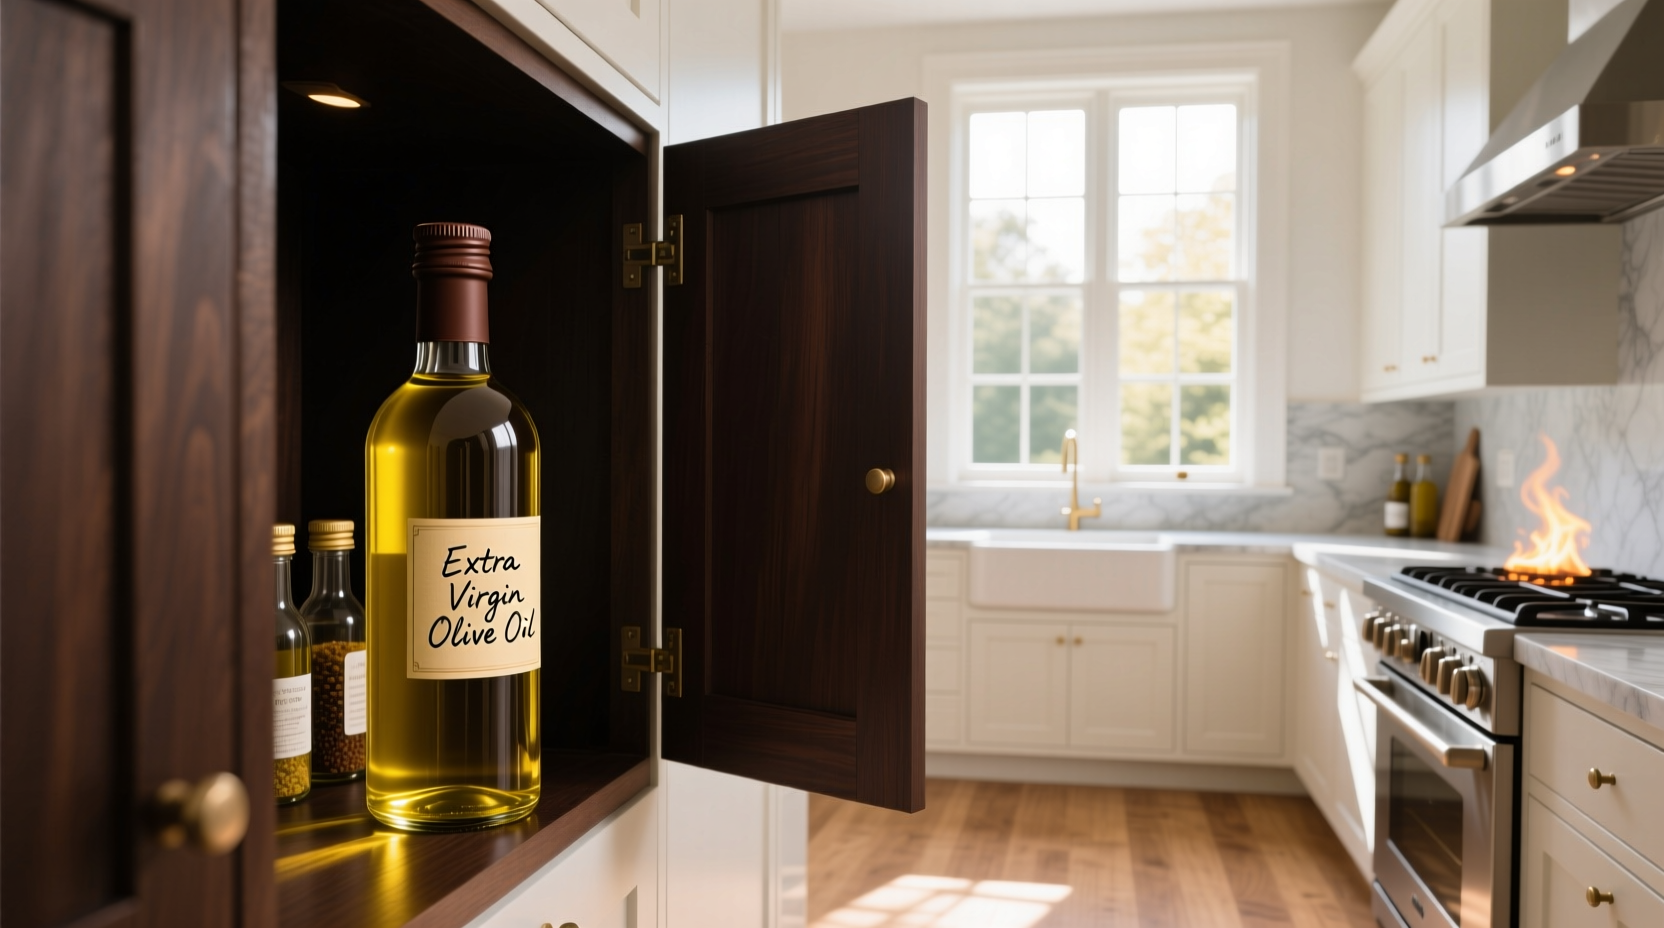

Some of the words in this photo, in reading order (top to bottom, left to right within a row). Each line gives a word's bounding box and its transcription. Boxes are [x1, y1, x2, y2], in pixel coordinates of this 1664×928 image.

[442, 545, 521, 578] Extra
[450, 580, 525, 623] Virgin
[428, 615, 497, 648] Olive
[504, 608, 535, 643] Oil
